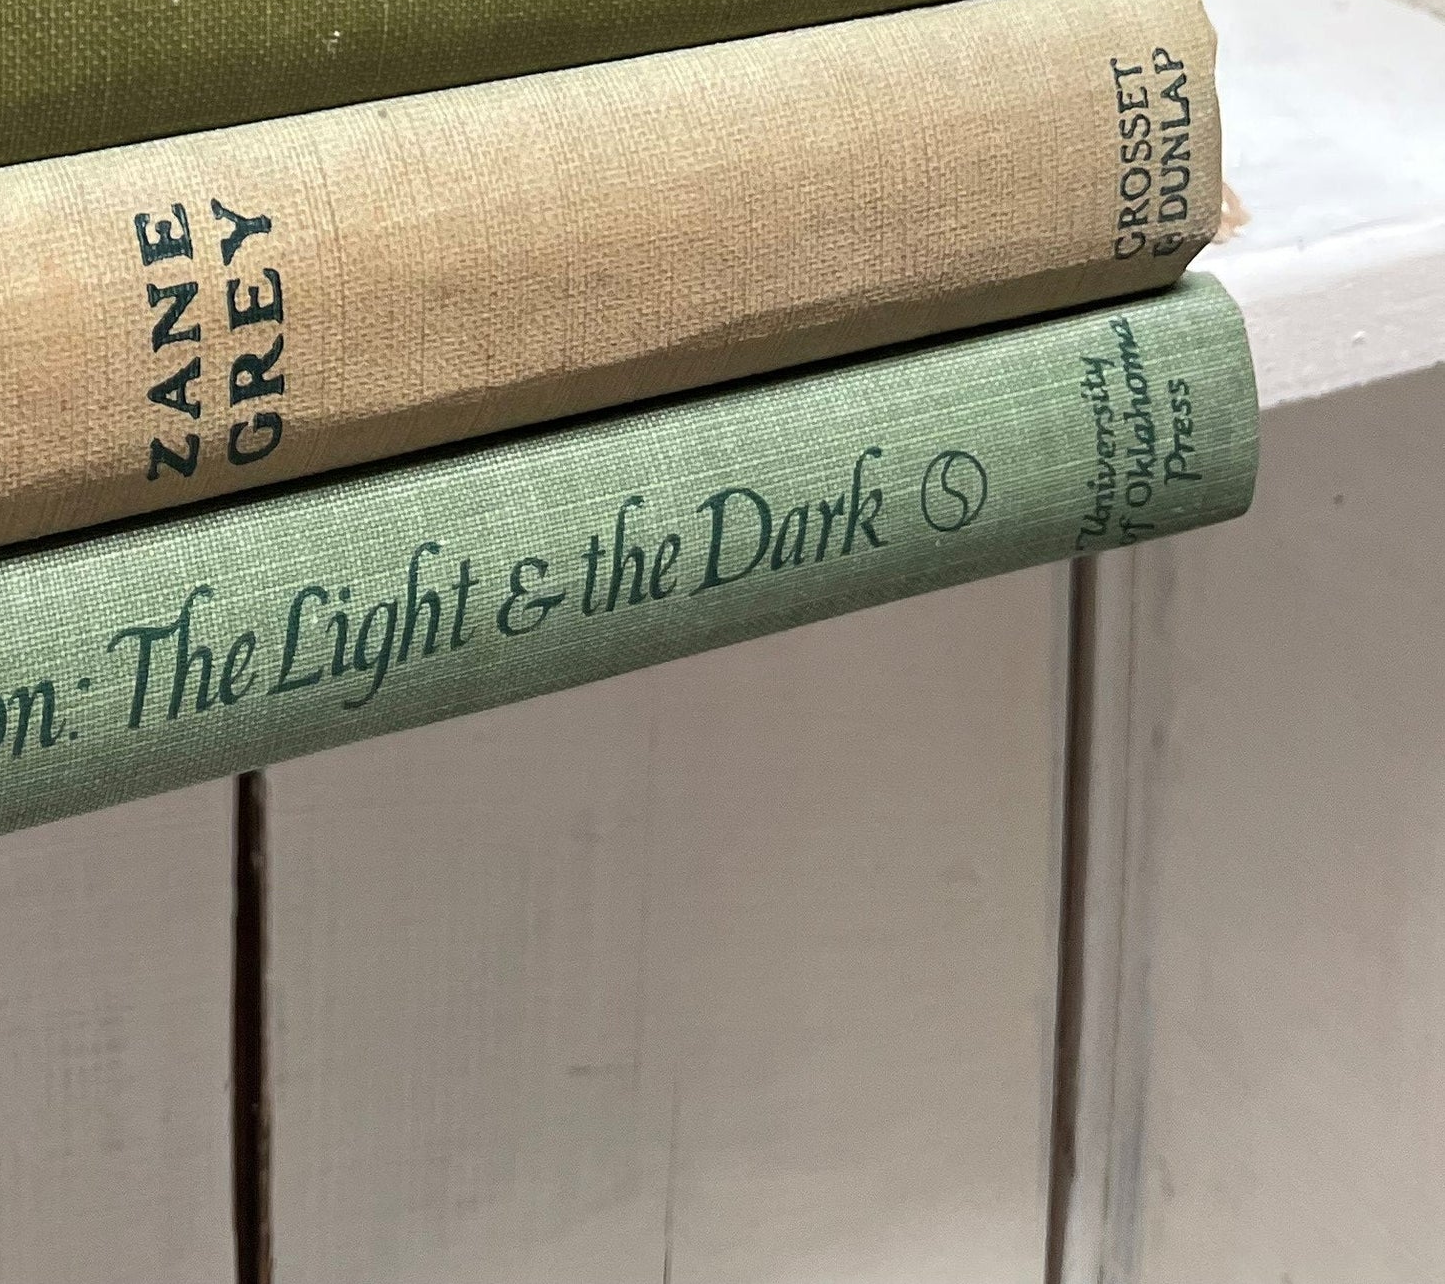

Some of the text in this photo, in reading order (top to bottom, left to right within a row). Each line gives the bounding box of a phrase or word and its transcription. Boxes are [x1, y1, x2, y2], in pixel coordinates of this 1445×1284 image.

[1109, 57, 1153, 261] GROSSET
[1152, 46, 1191, 224] DUNLAP
[133, 201, 203, 482] ZANE
[210, 196, 286, 467] GREY
[1108, 315, 1157, 546] of Oklahoma
[1163, 378, 1203, 486] Press
[1074, 355, 1117, 552] University
[106, 582, 257, 729] The
[266, 541, 481, 710] Light
[495, 555, 566, 636] &
[579, 494, 683, 618] the
[686, 445, 890, 598] Dark
